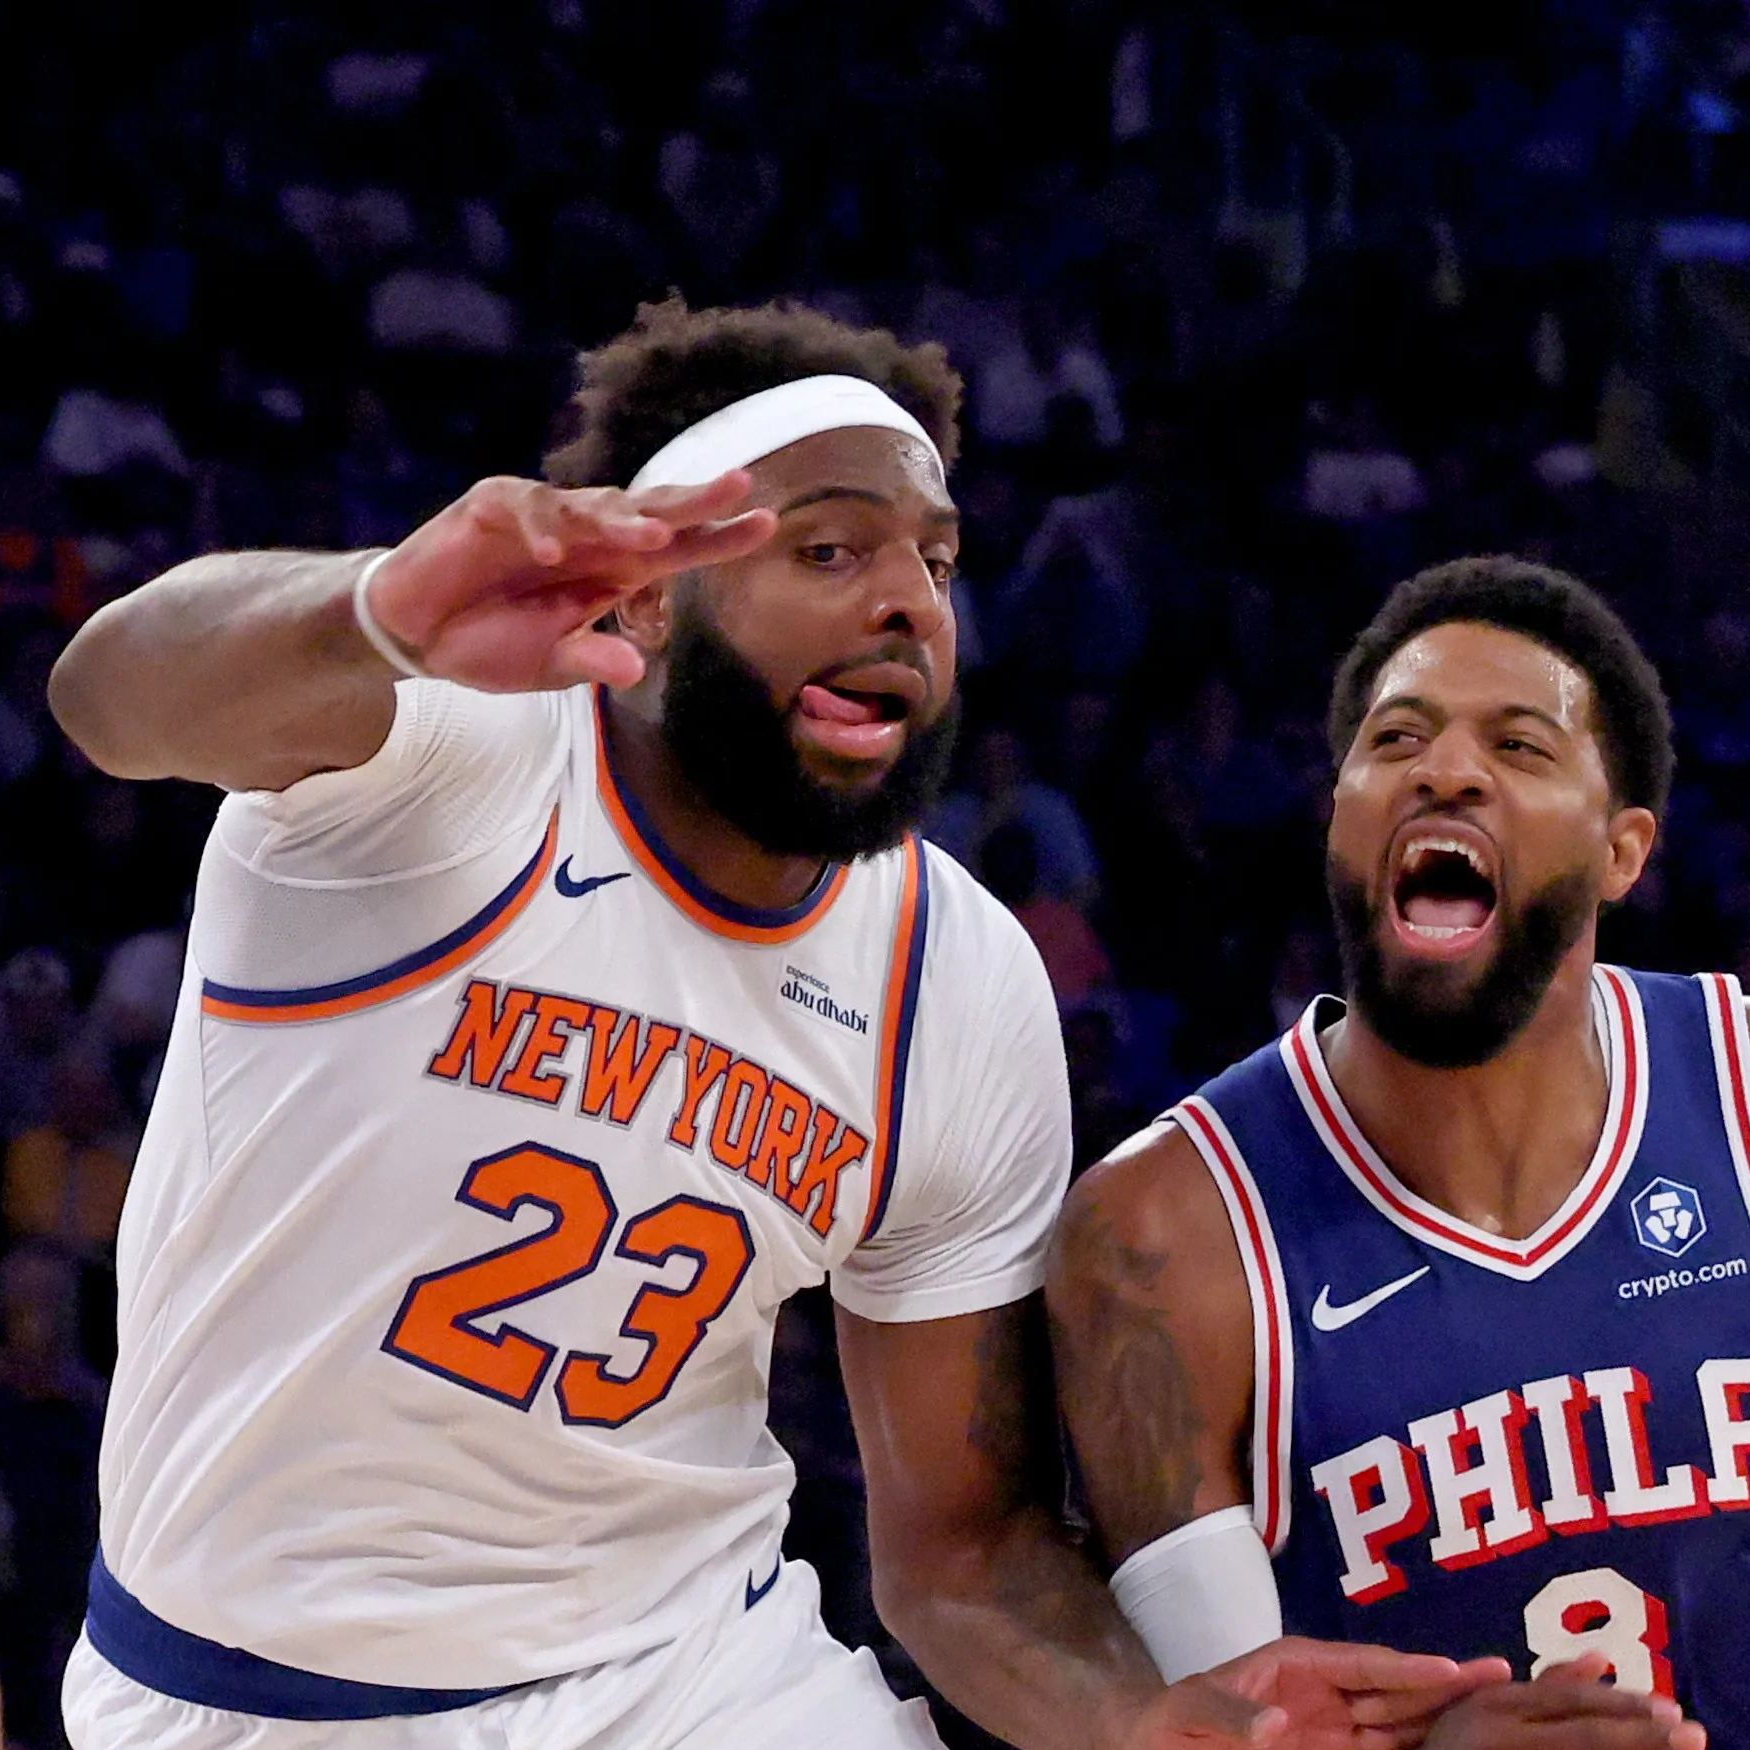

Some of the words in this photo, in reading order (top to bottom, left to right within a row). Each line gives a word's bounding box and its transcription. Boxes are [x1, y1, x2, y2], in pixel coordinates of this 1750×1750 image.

[780, 980, 815, 1010] abu
[816, 996, 869, 1035] dhabi
[424, 977, 681, 1130] NEW
[665, 1030, 872, 1244] YORK
[380, 1140, 755, 1428] 23
[1618, 1258, 1748, 1299] crypto.com
